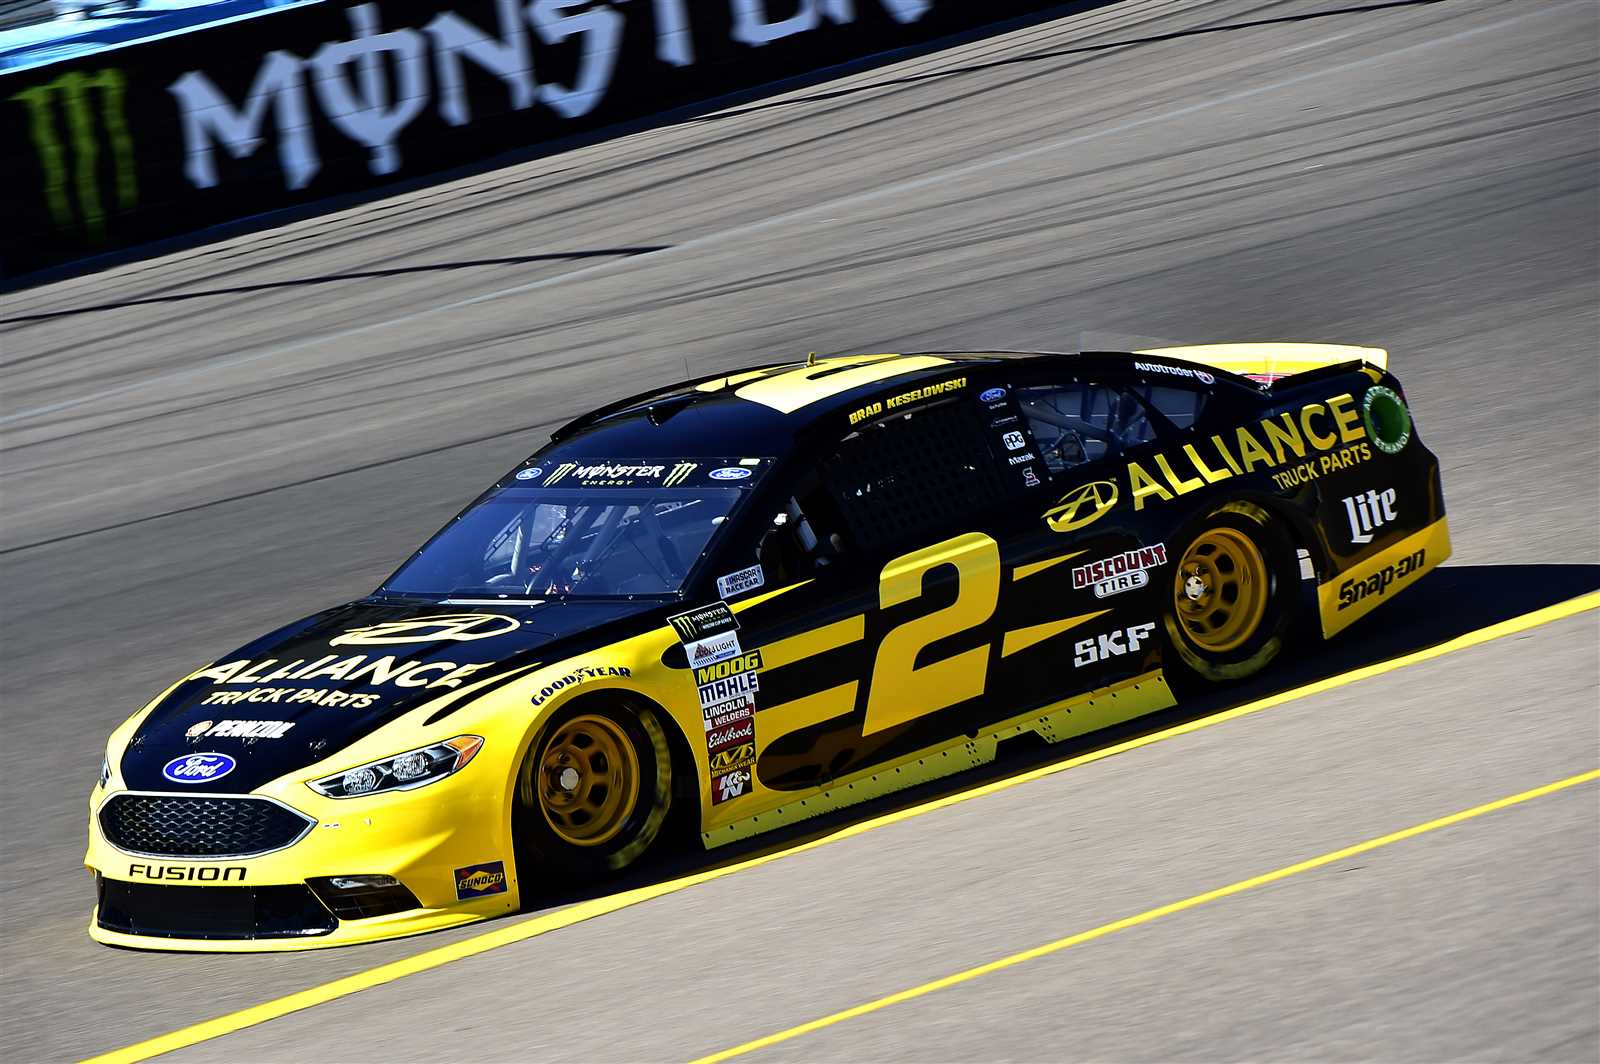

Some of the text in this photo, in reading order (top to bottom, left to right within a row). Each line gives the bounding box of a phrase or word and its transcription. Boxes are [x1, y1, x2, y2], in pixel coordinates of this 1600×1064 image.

[848, 377, 968, 426] BRAD KESELOWSKI
[1127, 392, 1367, 512] ALLIANCE
[571, 463, 665, 479] MONSTER
[1271, 442, 1372, 490] TRUCK PARTS
[1341, 487, 1398, 544] Lite
[1072, 542, 1168, 589] DISCOUNT
[725, 577, 759, 594] RACE CAR
[1100, 573, 1142, 594] TIRE
[690, 606, 728, 622] MONSTER
[862, 531, 1001, 737] 2
[1074, 622, 1156, 668] SKF
[189, 654, 497, 690] ALLIANCE
[698, 652, 759, 685] MOOG
[201, 687, 381, 709] TRUCK PARTS
[700, 671, 758, 704] MAHLE
[704, 697, 745, 719] LINCOLN
[714, 707, 750, 727] WELDERS
[708, 722, 753, 748] Edelbrock
[174, 755, 226, 780] Ford
[129, 864, 248, 881] FUSION
[459, 872, 504, 890] SUNOCO
